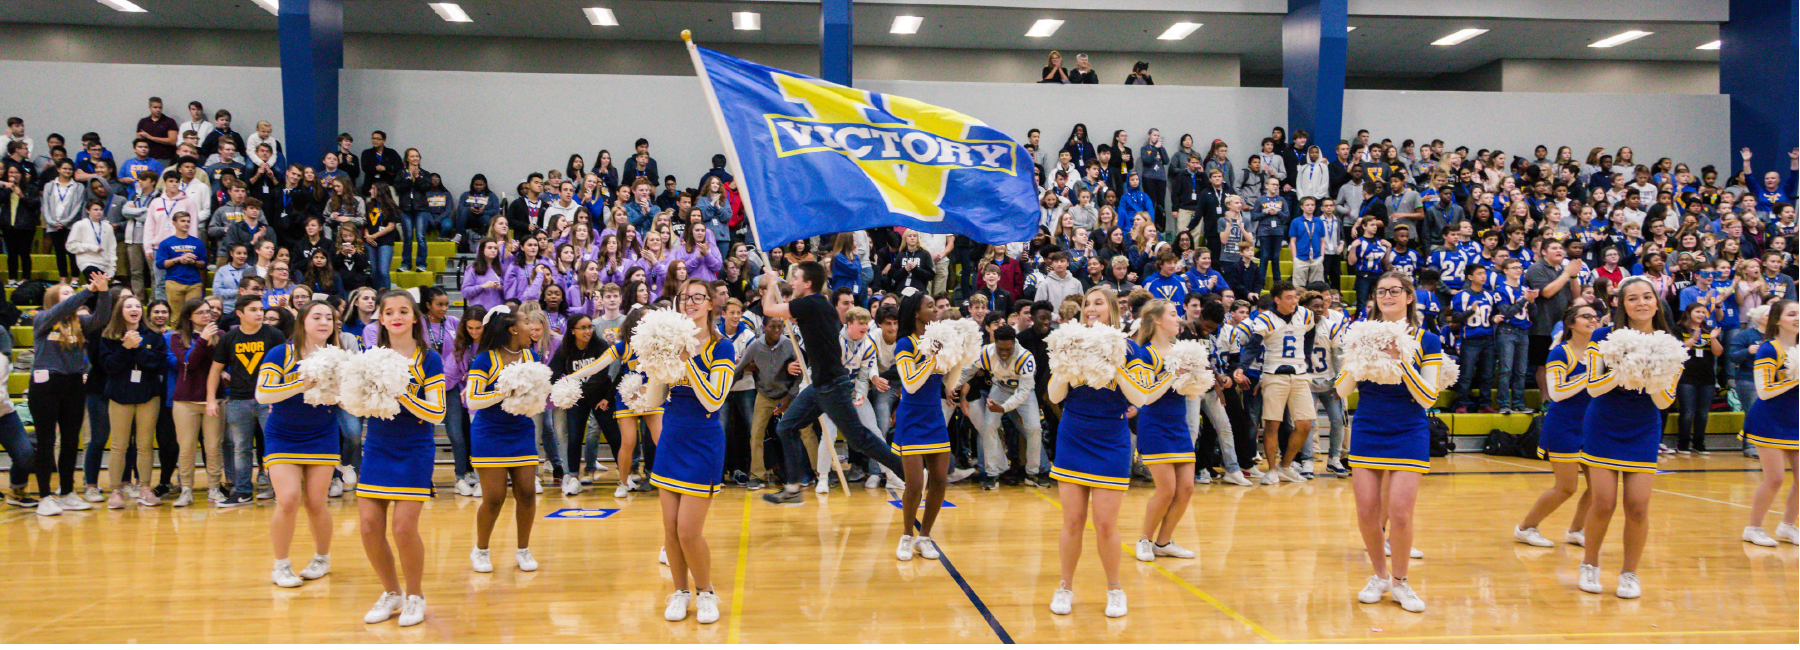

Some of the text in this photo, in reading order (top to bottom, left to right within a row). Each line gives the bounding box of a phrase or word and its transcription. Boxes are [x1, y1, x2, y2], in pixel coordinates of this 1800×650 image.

[777, 120, 1008, 168] VICTORY
[1441, 261, 1465, 281] 24
[235, 341, 264, 352] CNQR
[1282, 336, 1297, 358] 6
[1021, 360, 1034, 374] 18
